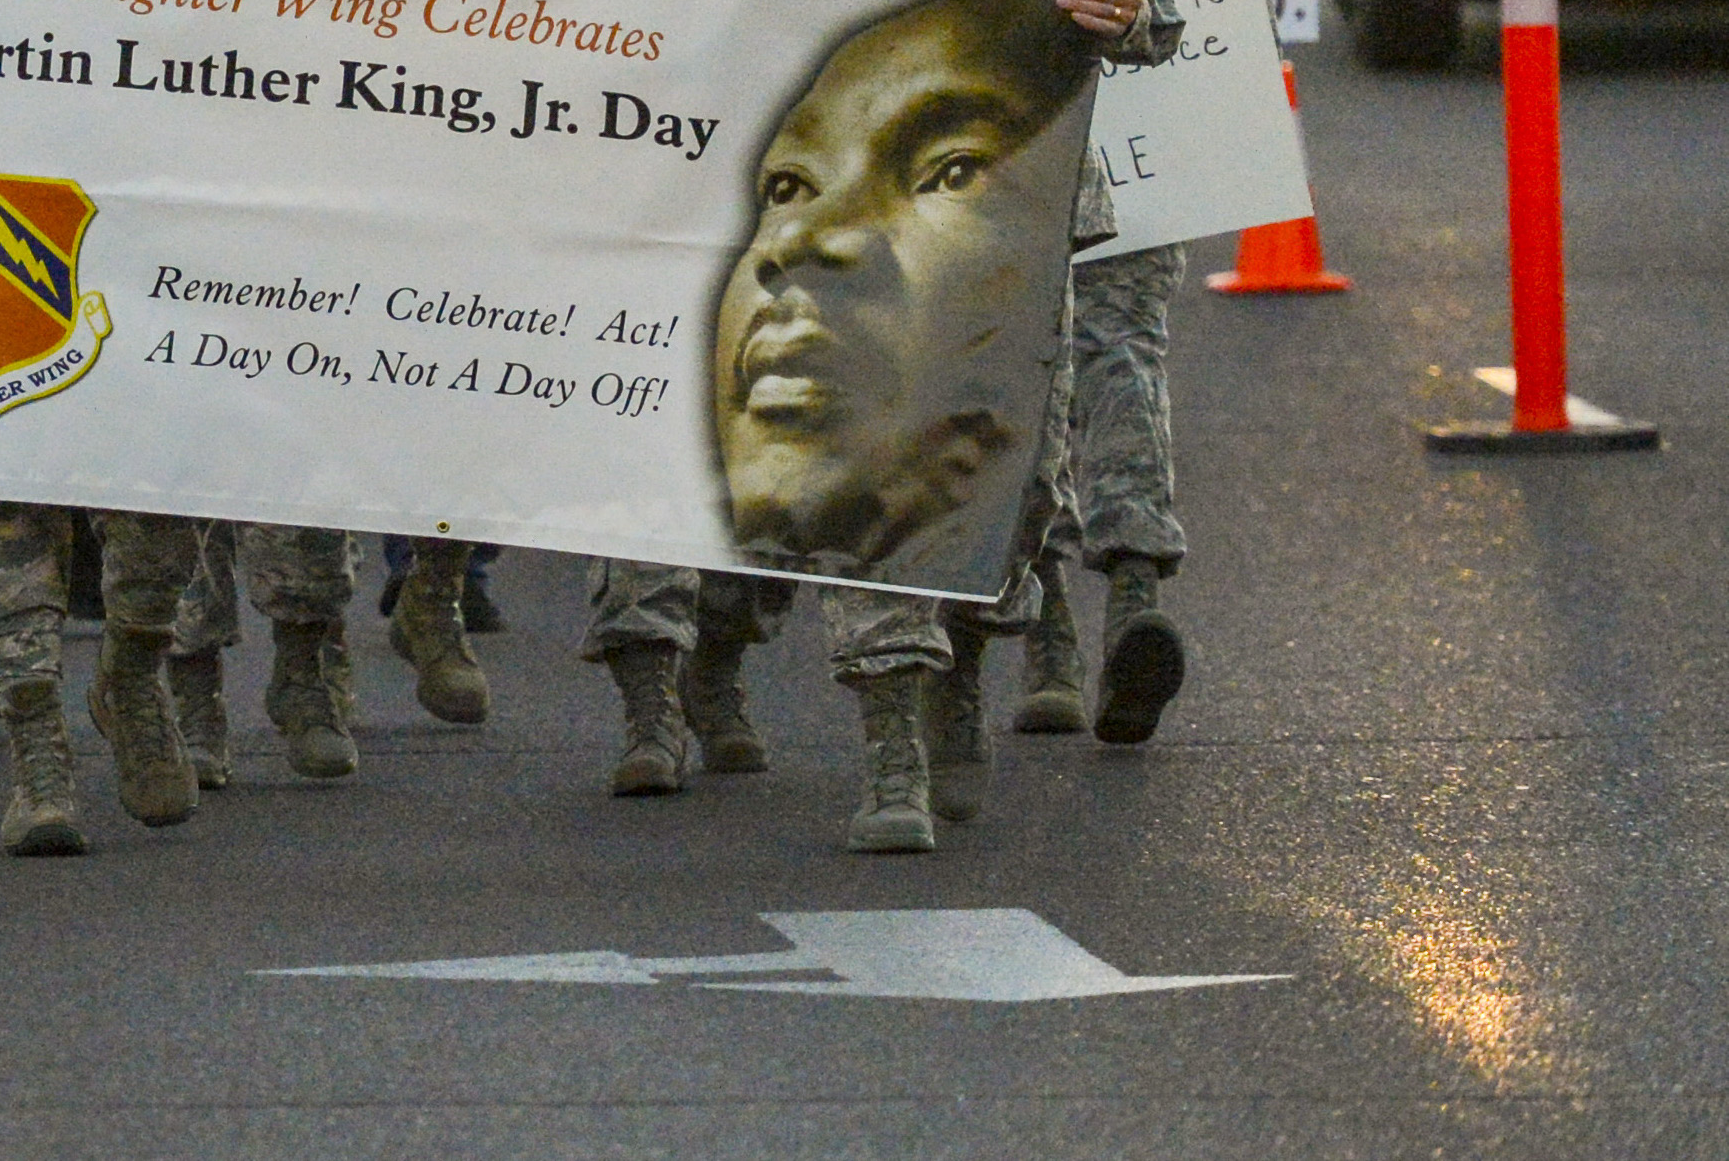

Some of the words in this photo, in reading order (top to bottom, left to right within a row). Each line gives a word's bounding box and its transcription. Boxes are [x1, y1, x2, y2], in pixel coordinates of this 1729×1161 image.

[112, 38, 320, 106] Luther
[336, 60, 496, 134] King,
[509, 79, 579, 139] Jr.
[598, 90, 721, 161] Day
[148, 265, 361, 317] Remember!
[386, 287, 576, 337] Celebrate!
[595, 309, 679, 348] Act!
[28, 348, 85, 388] WING
[144, 330, 176, 364] A
[191, 333, 272, 379] Day
[286, 341, 353, 386] On,
[366, 349, 440, 389] Not
[447, 358, 480, 392] A
[494, 362, 577, 409] Day
[591, 373, 670, 418] Off!
